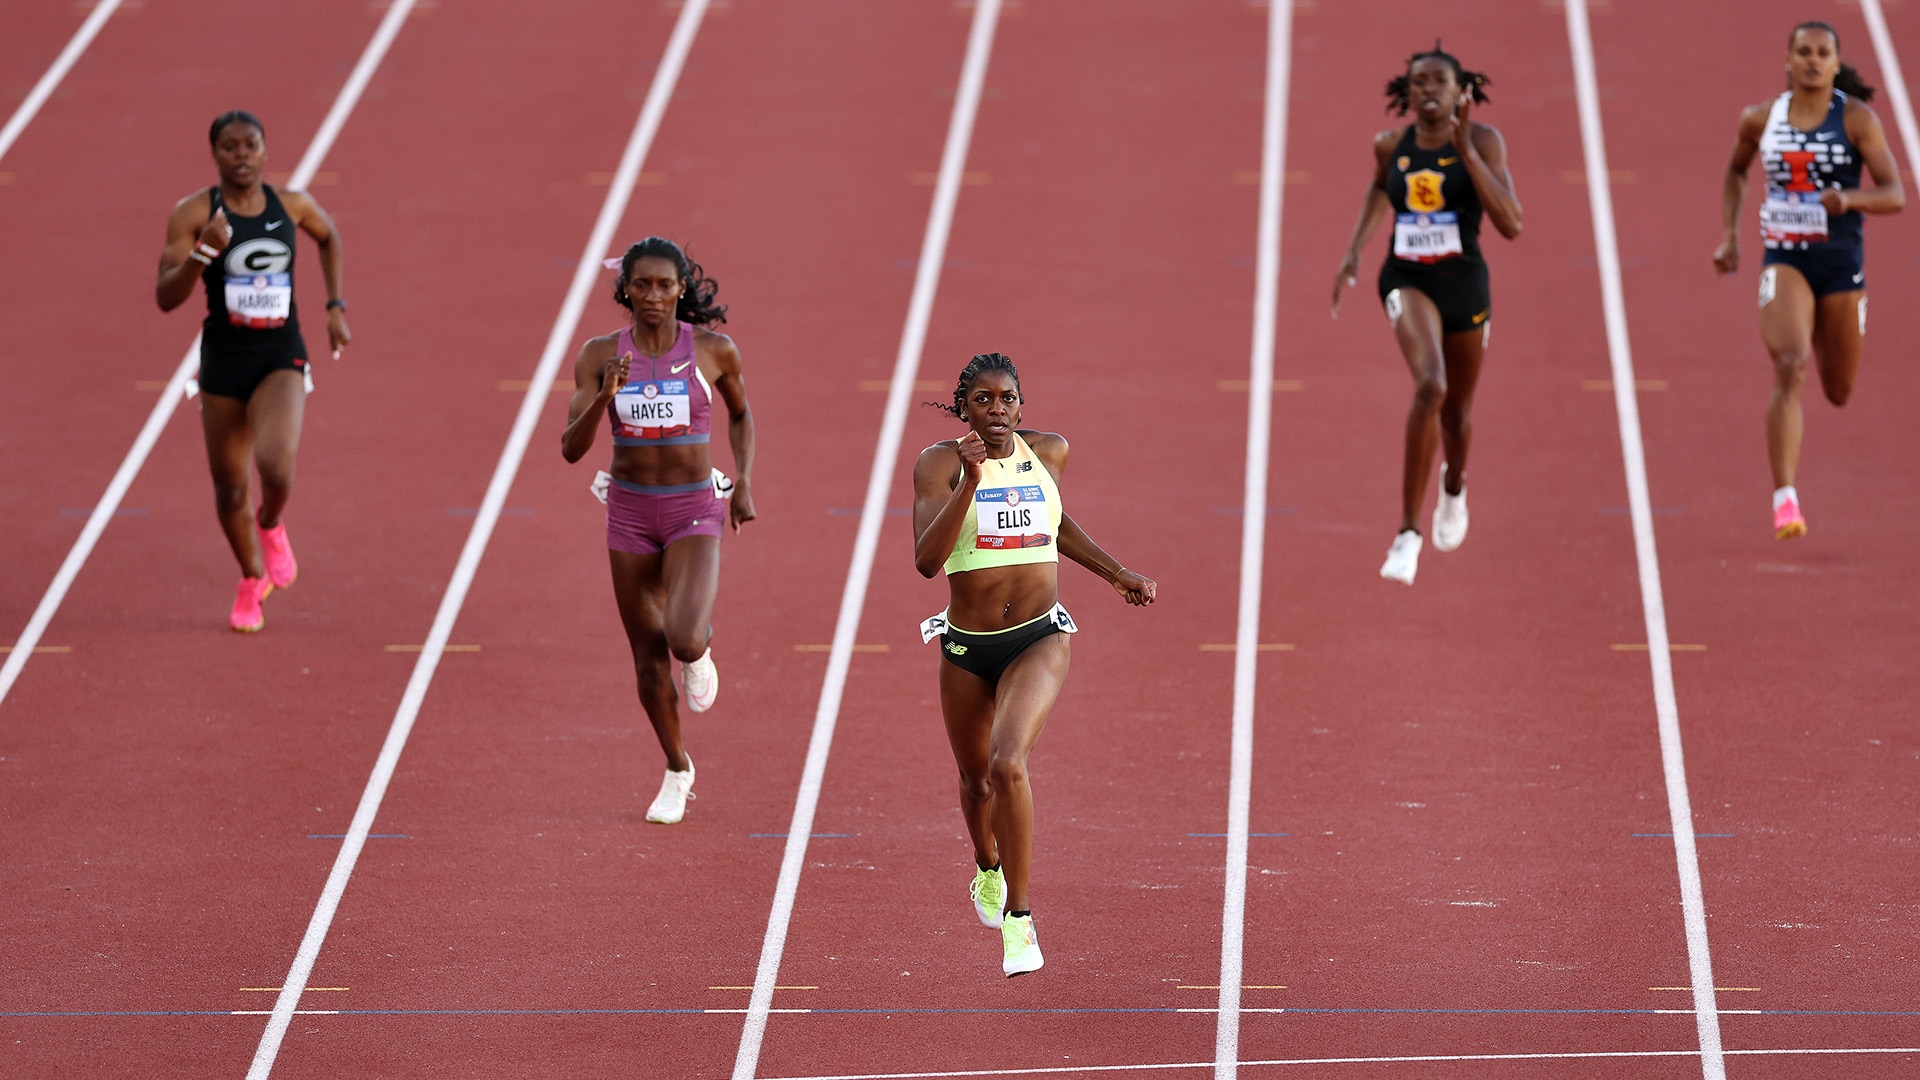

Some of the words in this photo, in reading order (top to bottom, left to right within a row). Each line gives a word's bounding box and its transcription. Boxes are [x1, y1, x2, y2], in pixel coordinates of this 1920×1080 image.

[224, 237, 291, 276] G
[631, 401, 674, 420] HAYES
[997, 508, 1031, 529] ELLIS
